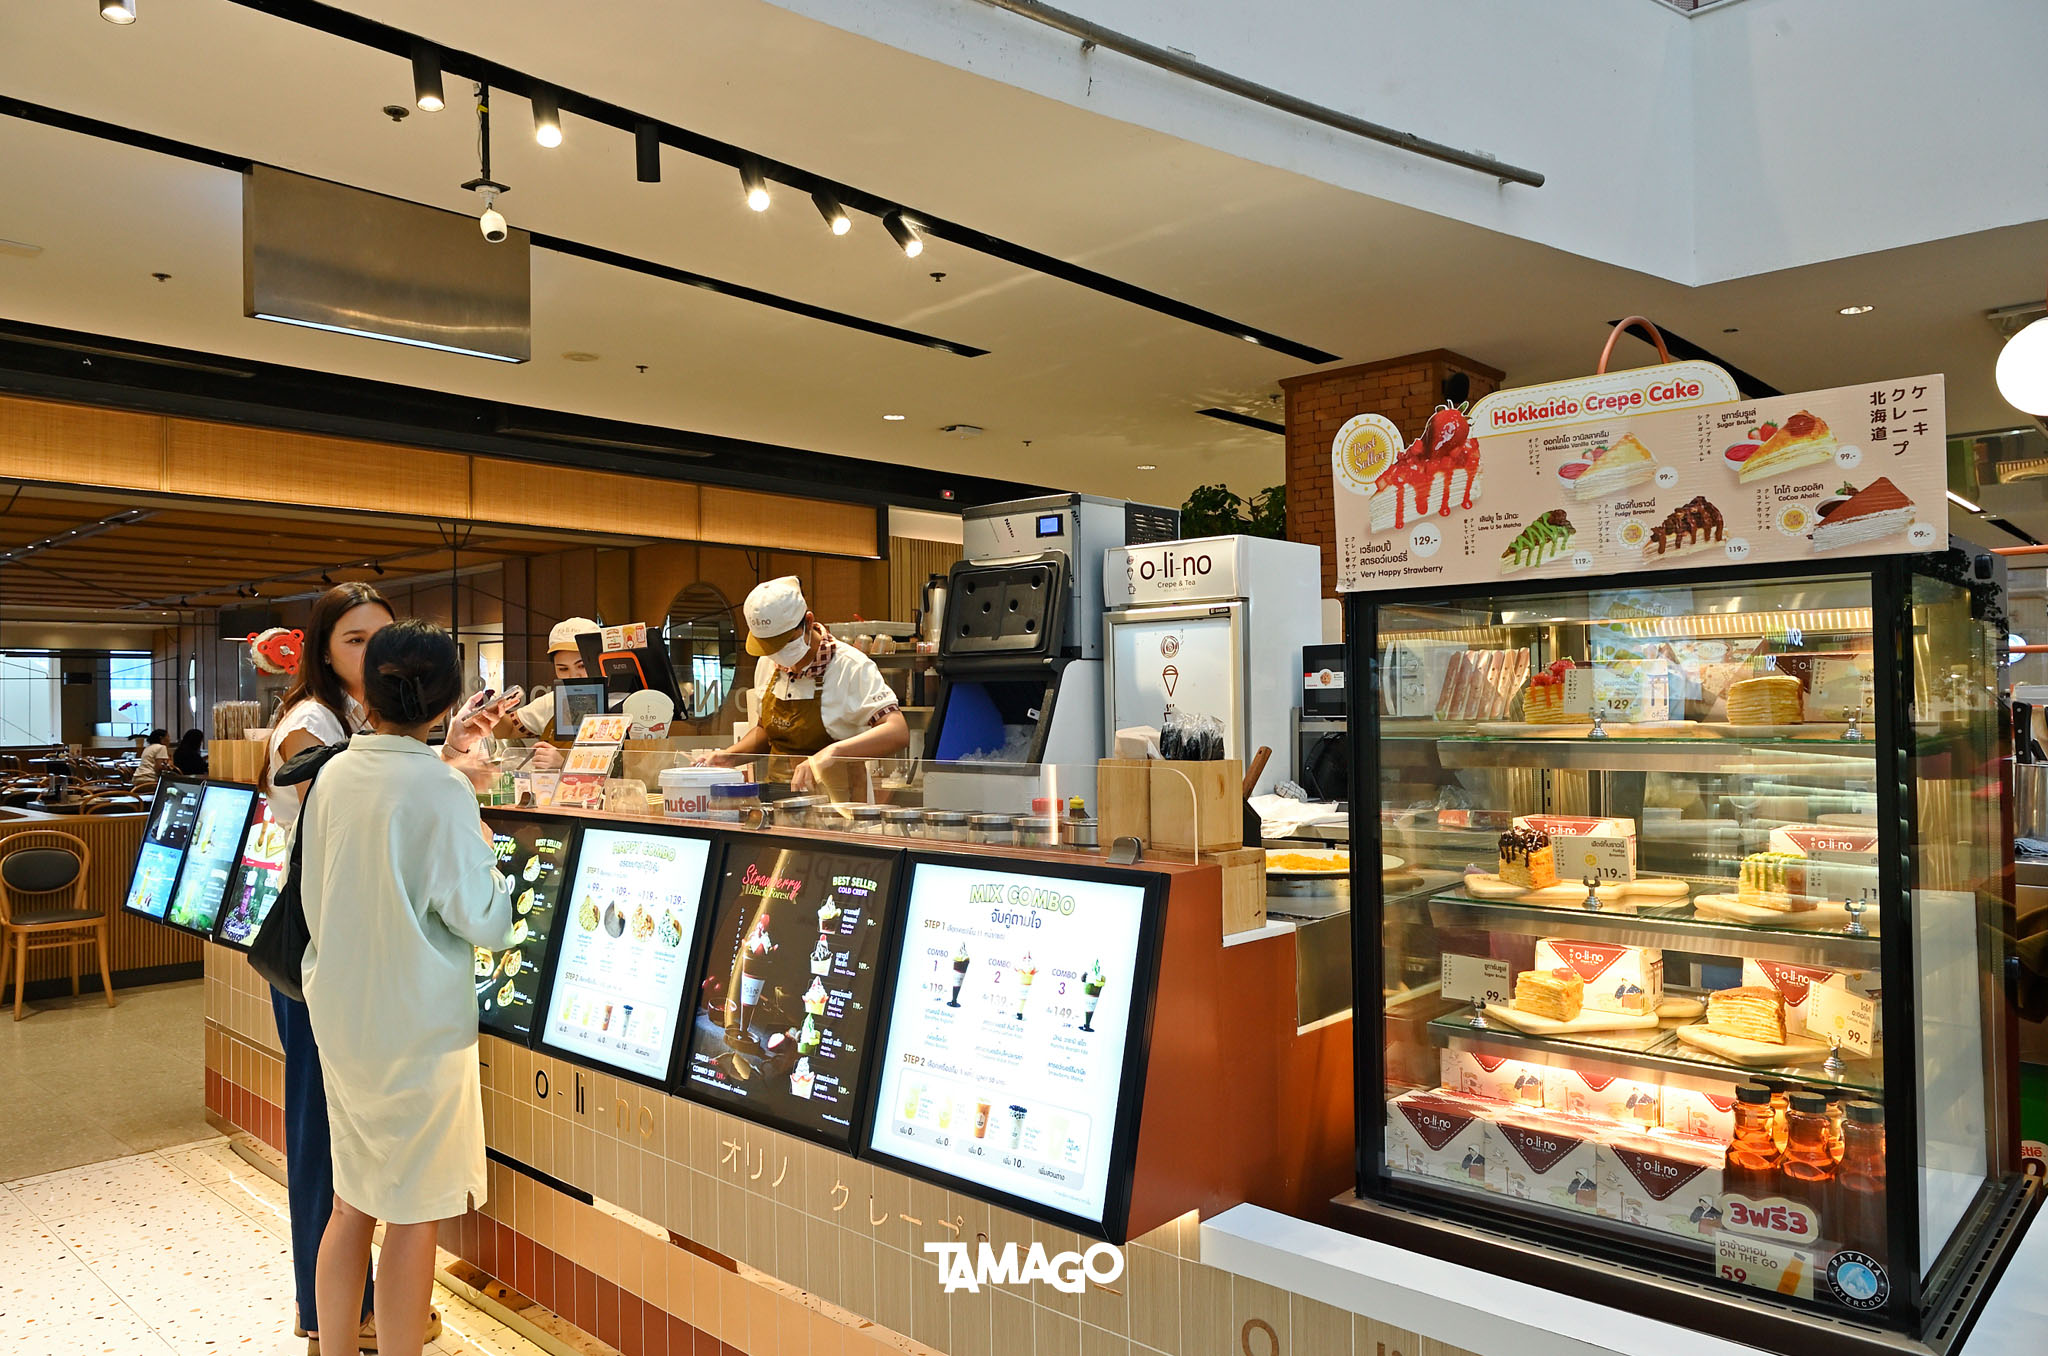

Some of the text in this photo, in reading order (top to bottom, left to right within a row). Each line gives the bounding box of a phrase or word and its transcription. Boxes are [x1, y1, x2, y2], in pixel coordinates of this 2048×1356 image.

[1493, 381, 1700, 426] Hokkaido Crepe Cake
[1912, 385, 1929, 435] ケーキ
[1869, 391, 1888, 442] 北海道
[1891, 388, 1910, 457] クレープ
[1717, 421, 1733, 429] Sugar
[1351, 434, 1377, 457] Best
[1591, 439, 1609, 447] Cream
[1354, 448, 1387, 474] Seller
[1840, 452, 1857, 462] 99.-
[1632, 508, 1656, 516] Brownie
[1004, 518, 1015, 539] Nitto
[1503, 521, 1522, 529] Matcha
[1414, 535, 1438, 546] 129.-
[1914, 530, 1930, 538] 99.-
[1728, 545, 1748, 553] 119.-
[1140, 551, 1212, 580] o-li-no
[1360, 565, 1443, 579] Very Happy Strawberry
[1608, 699, 1640, 710] 129.-
[612, 840, 676, 862] HAPPY COMBO
[1818, 837, 1852, 851] o-li-no
[1597, 868, 1628, 879] 119.-
[742, 864, 802, 901] Strawberry
[832, 876, 878, 892] BEST SELLER
[748, 885, 790, 900] Black Forest
[838, 886, 869, 897] COLD CREPE
[969, 884, 1075, 916] MIX COMBO
[924, 919, 941, 930] STEP
[991, 908, 1042, 929] จับคู่ตามใจ
[927, 948, 949, 958] COMBO
[1575, 950, 1604, 964] o-li-no
[988, 958, 1011, 969] COMBO
[994, 971, 1001, 984] 2
[1052, 968, 1077, 980] COMBO
[1781, 970, 1810, 985] o-li-no
[1058, 982, 1066, 995] 3
[1486, 990, 1507, 1002] 99.-
[1053, 1006, 1080, 1020] 149.-
[1848, 1029, 1868, 1045] 99.-
[903, 1053, 920, 1065] STEP
[1423, 1114, 1451, 1130] o-li-no
[1525, 1136, 1557, 1152] o-li-no
[720, 1137, 789, 1188] オリノ
[1643, 1160, 1678, 1177] o-li-no
[1730, 1202, 1808, 1235] 3ฟรี3
[1719, 1239, 1767, 1258] ชาข้าวหอม
[1719, 1248, 1778, 1269] ON THE GO
[1832, 1254, 1881, 1277] PATANA
[1831, 1281, 1885, 1308] INTERCOOL
